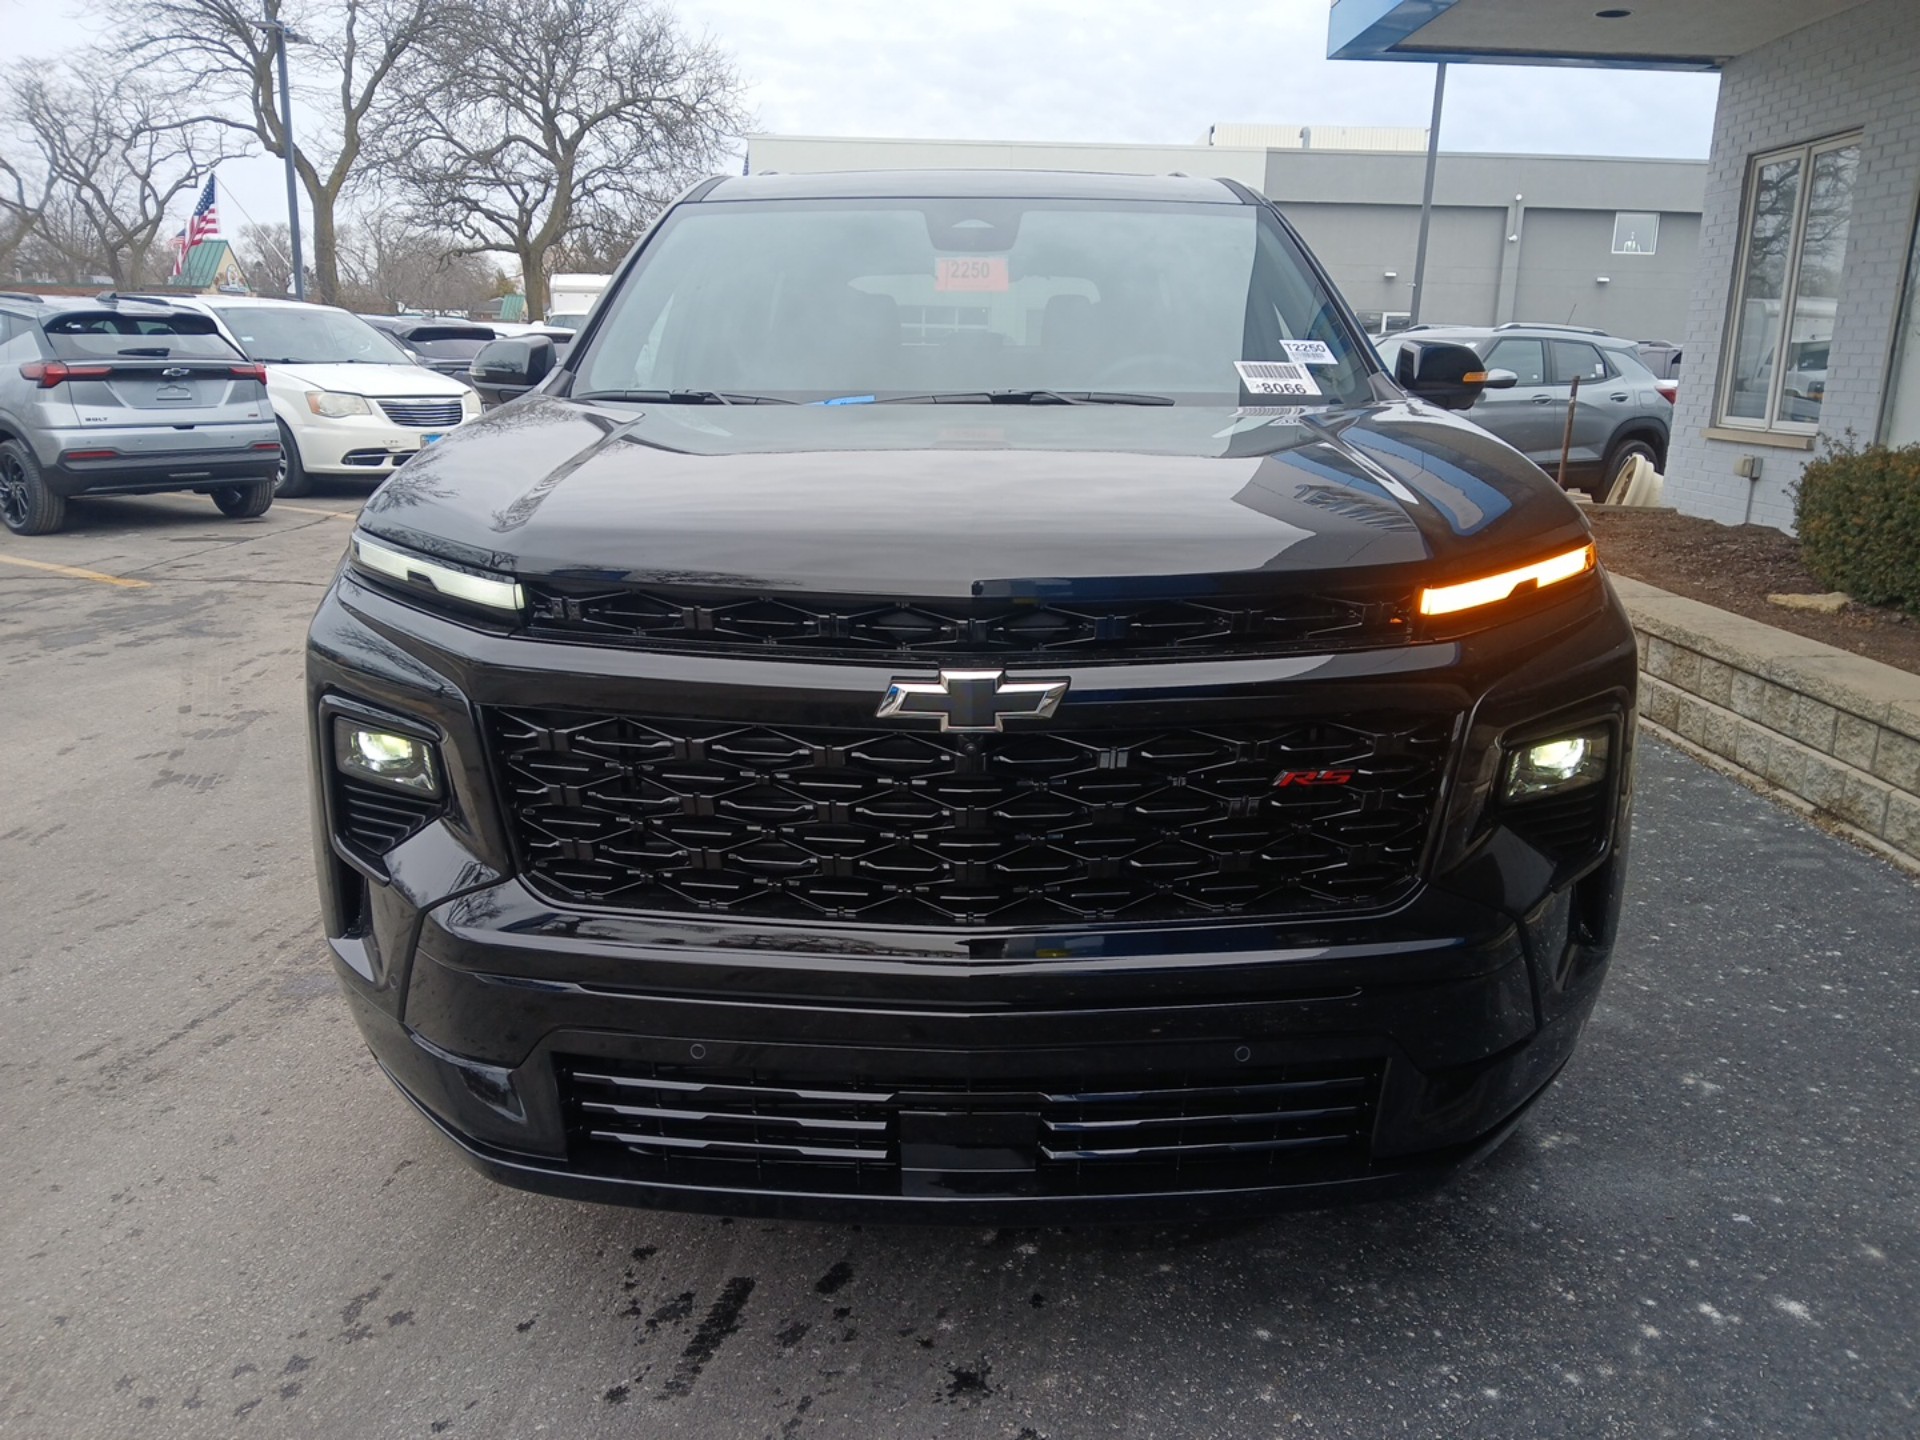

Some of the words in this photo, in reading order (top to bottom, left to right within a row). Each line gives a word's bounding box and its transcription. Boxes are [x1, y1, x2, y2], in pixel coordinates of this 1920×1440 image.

[1284, 343, 1326, 353] T2250
[1262, 382, 1307, 395] 8066
[1273, 769, 1355, 788] RS
